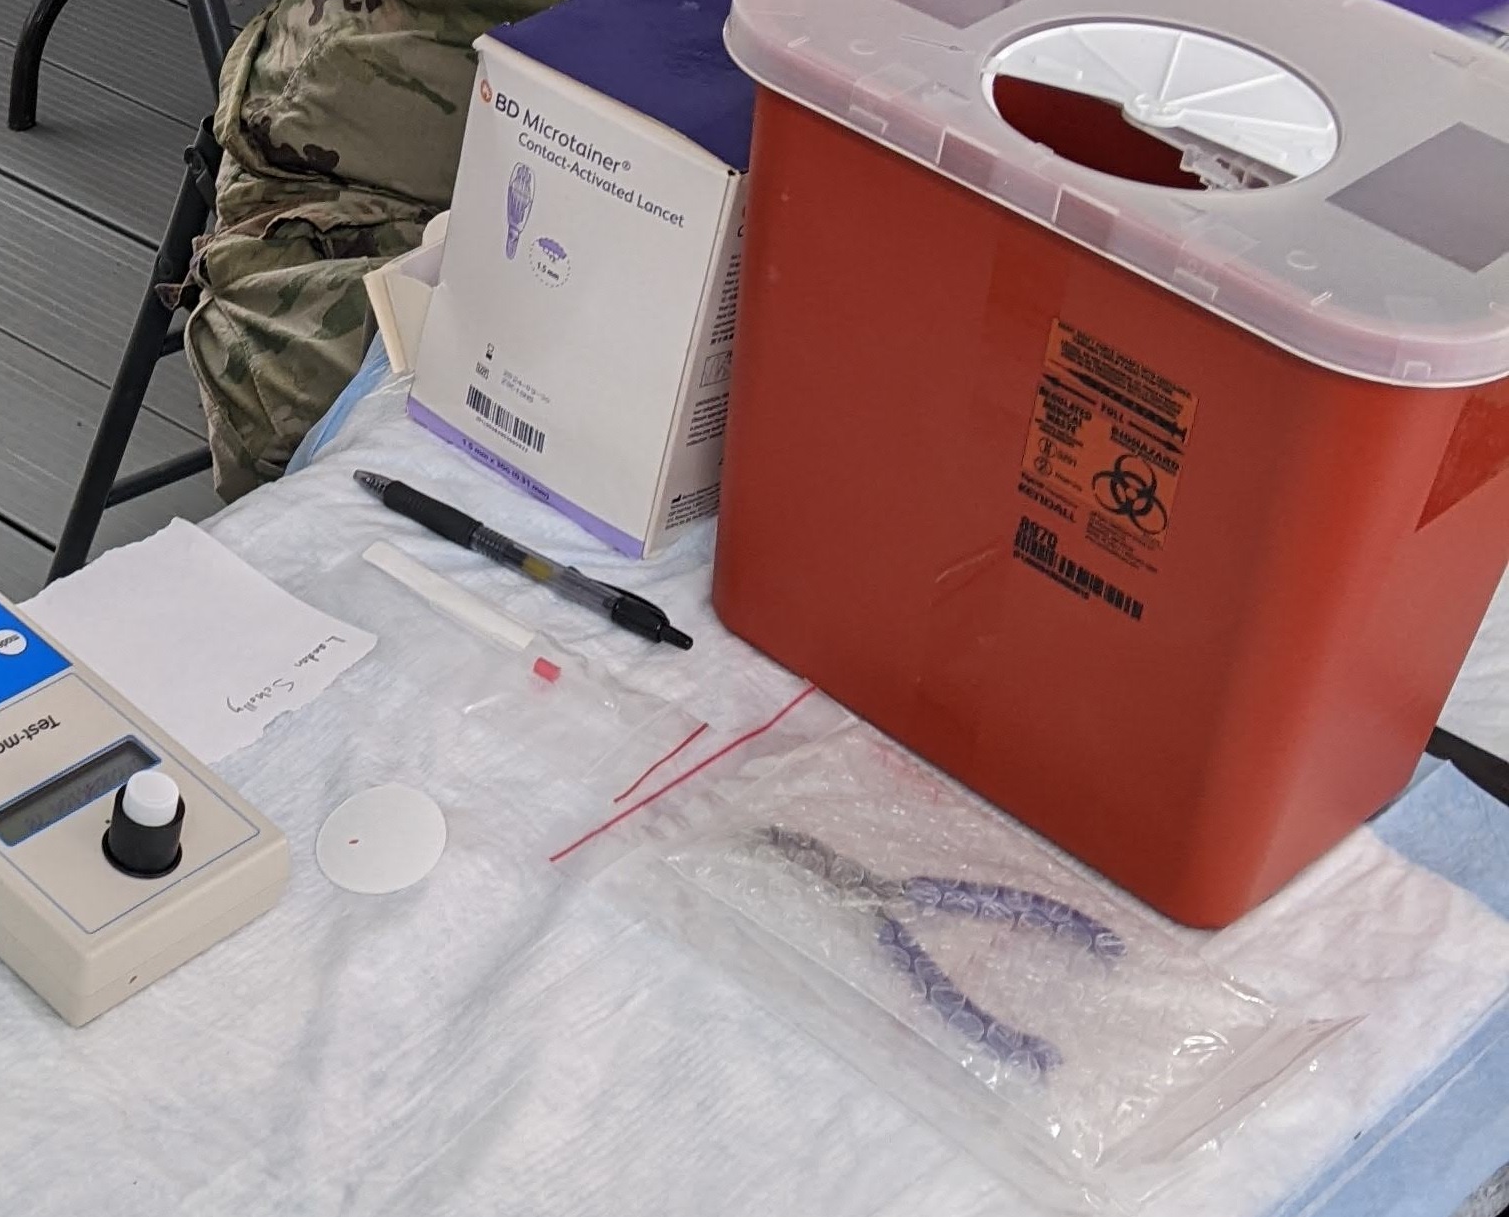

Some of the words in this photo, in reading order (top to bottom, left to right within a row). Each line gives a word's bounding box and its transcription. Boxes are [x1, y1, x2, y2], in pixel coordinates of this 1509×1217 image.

[494, 92, 520, 119] BD
[518, 131, 635, 204] Contact-Activated
[637, 194, 686, 228] Lancet
